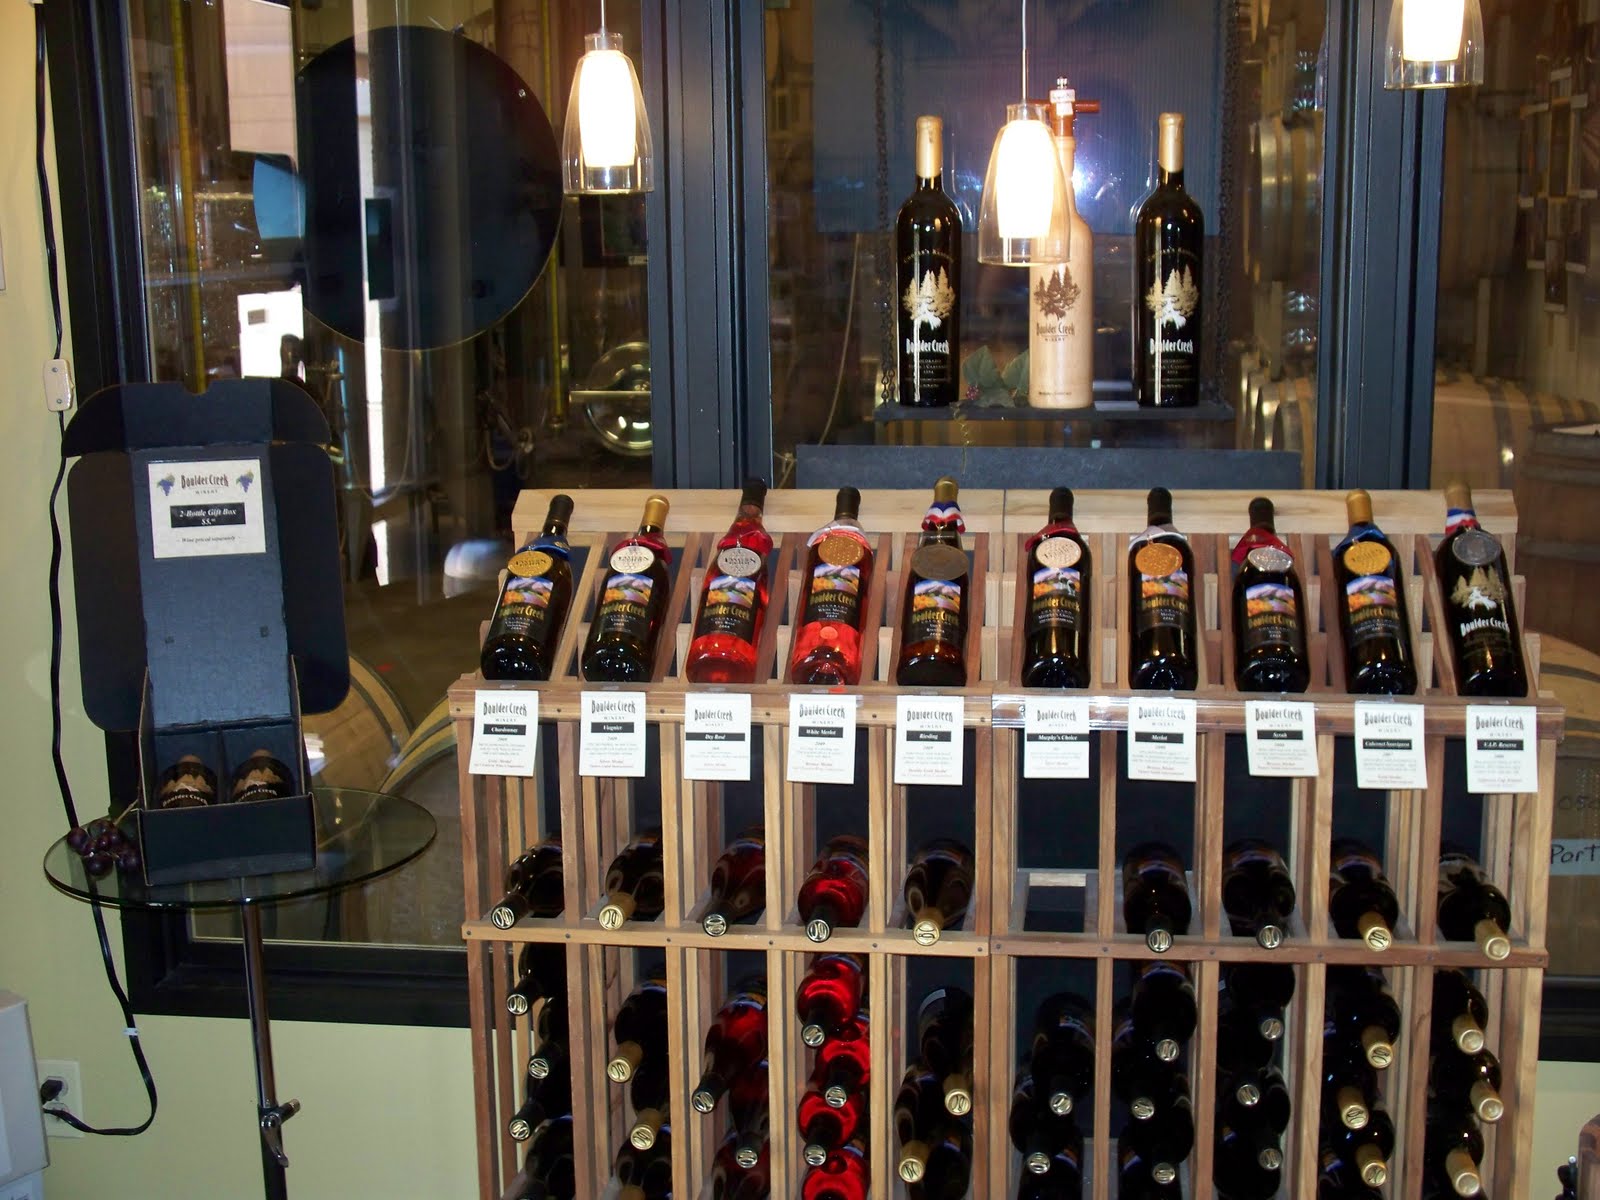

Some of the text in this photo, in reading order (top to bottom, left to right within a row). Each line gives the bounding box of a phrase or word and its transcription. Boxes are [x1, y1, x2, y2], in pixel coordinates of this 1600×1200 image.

[1058, 322, 1075, 336] Creek
[932, 339, 950, 354] Creek
[1177, 338, 1193, 354] Creek
[181, 474, 229, 489] Boulder Creek
[208, 508, 221, 516] Gift
[1460, 617, 1510, 638] Boulder Creek
[483, 702, 527, 718] Boulder Creek
[592, 700, 636, 714] Boulder Creek
[799, 704, 845, 719] Boulder Creek
[1138, 706, 1186, 720] Boulder Creek
[694, 708, 733, 721] Boulder Creek
[907, 710, 953, 722] Boulder Creek
[1037, 710, 1077, 722] Boulder Creek
[1256, 708, 1302, 722] Boulder Creek
[1364, 712, 1412, 726] Boulder Creek
[1476, 716, 1524, 730] Boulder Creek
